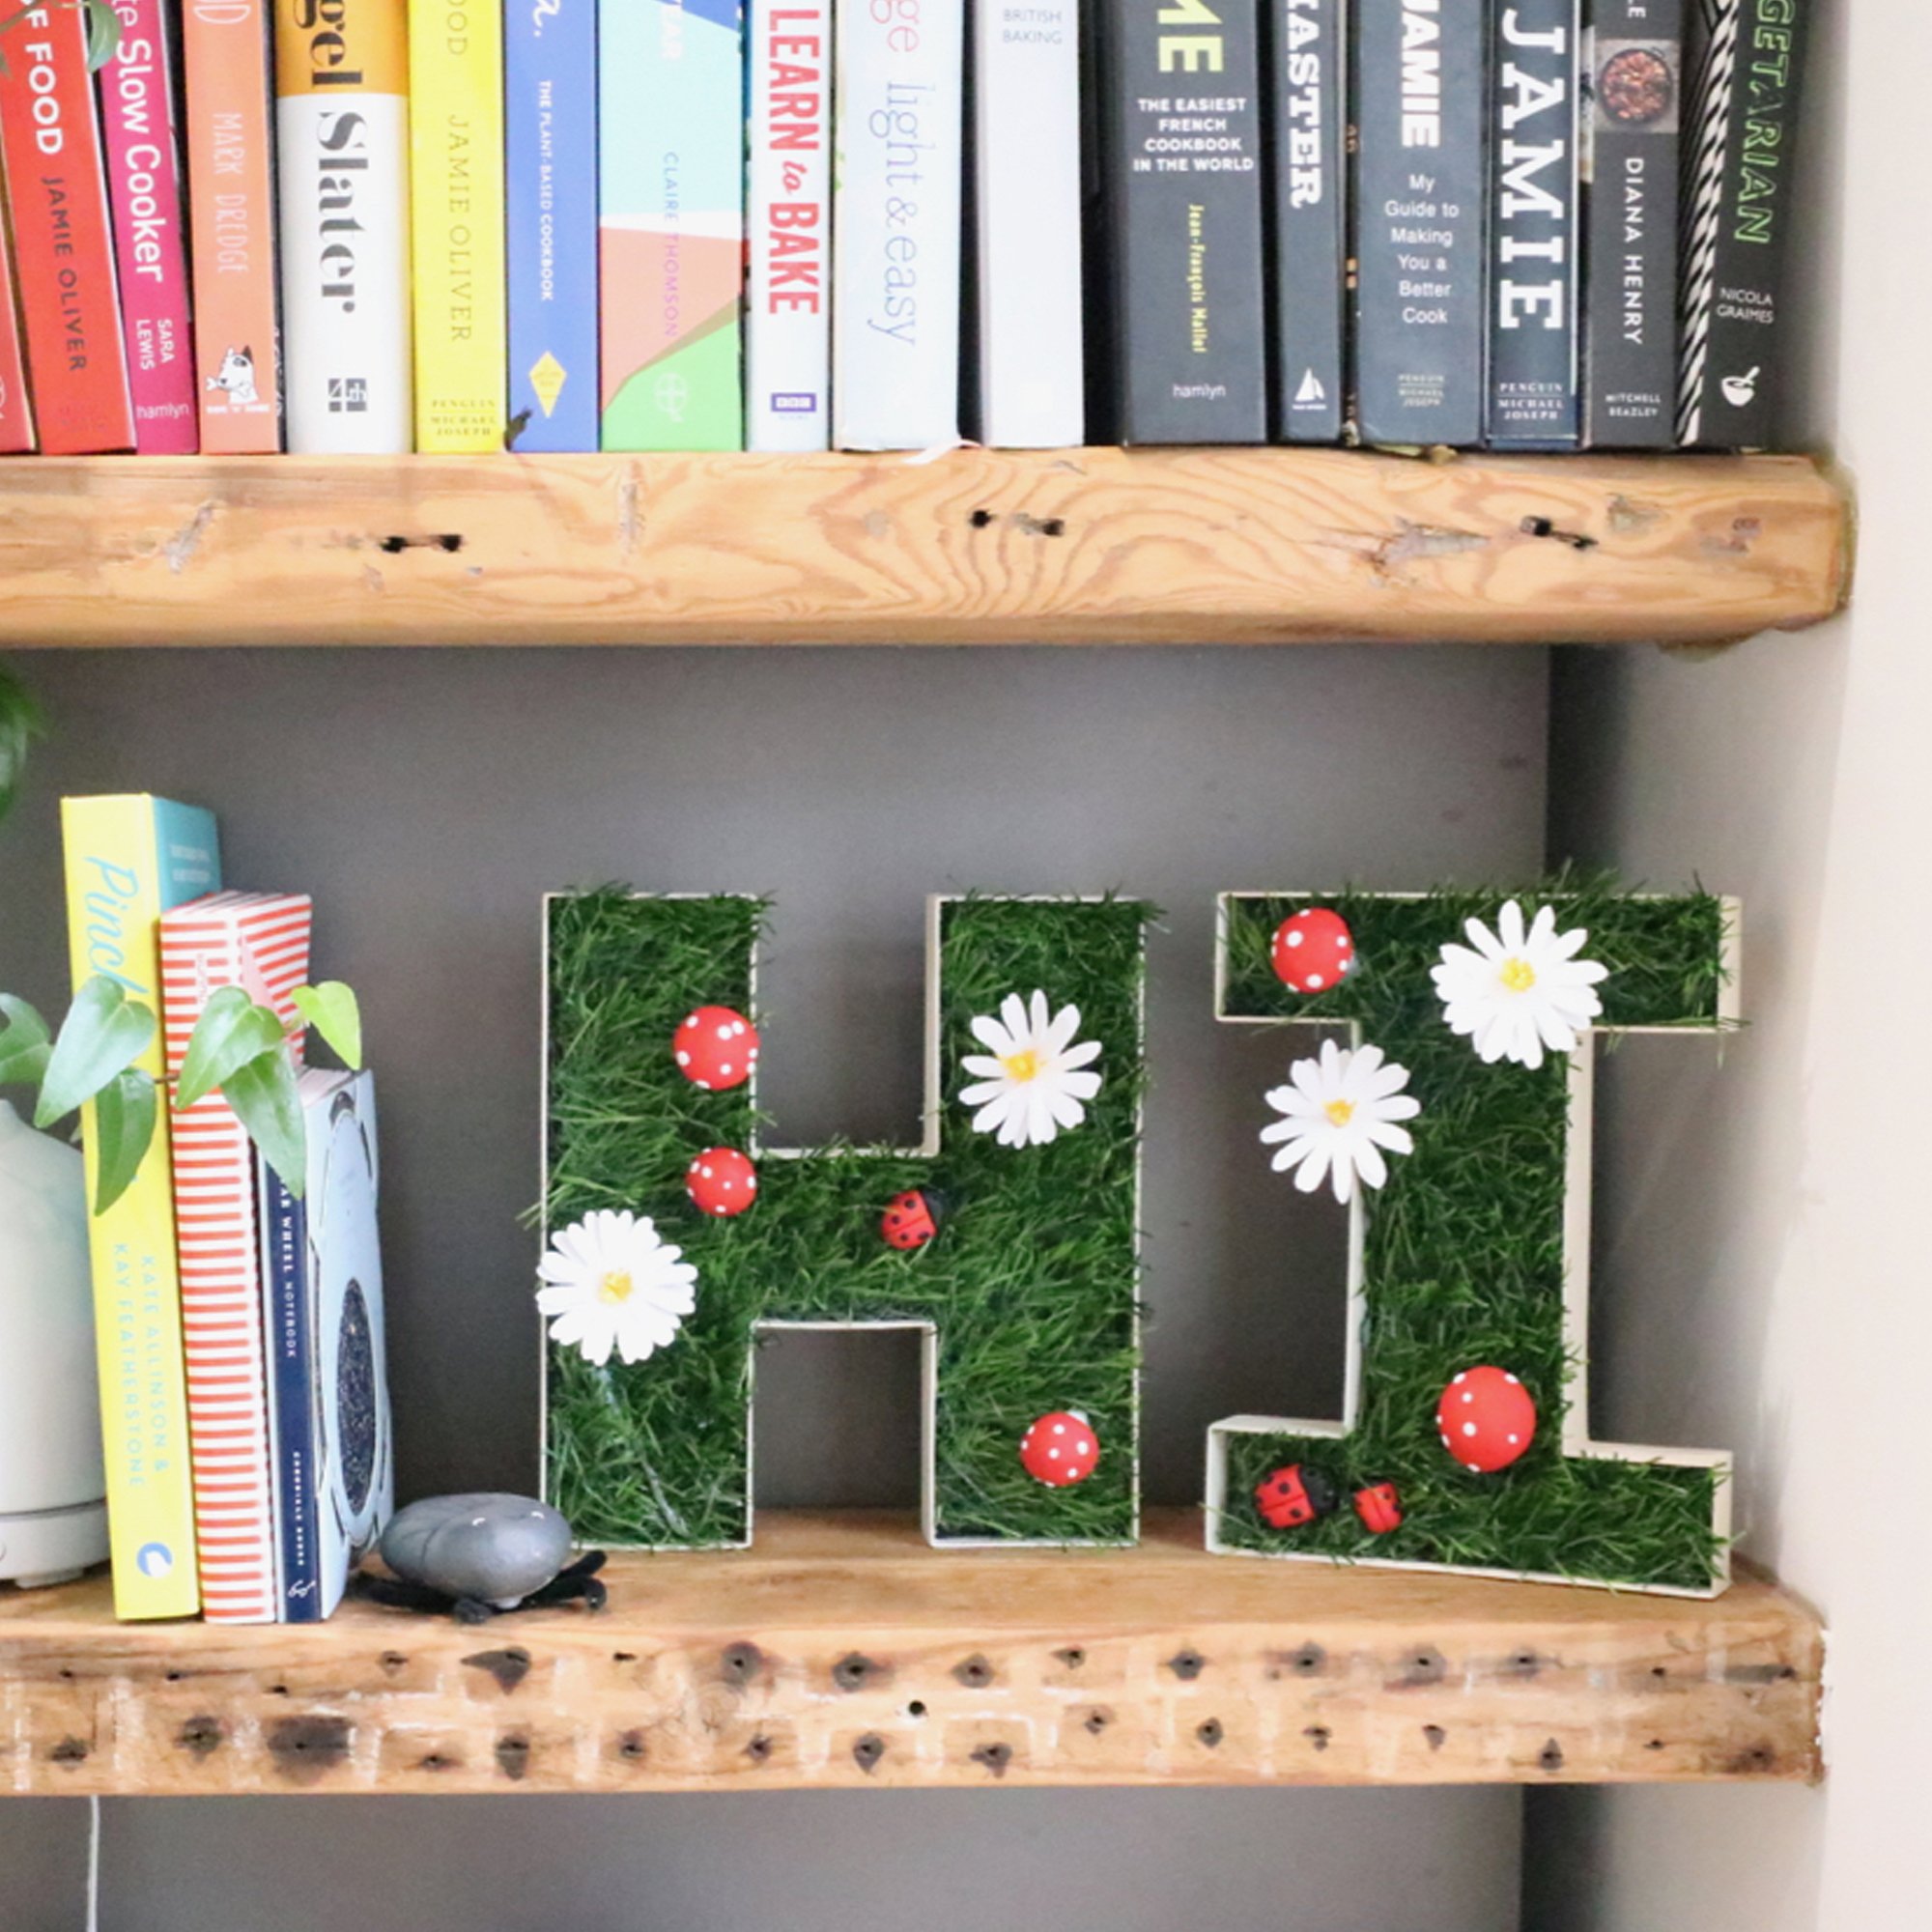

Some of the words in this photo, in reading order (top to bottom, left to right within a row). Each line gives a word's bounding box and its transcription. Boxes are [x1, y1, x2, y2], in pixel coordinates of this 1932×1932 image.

[1002, 8, 1062, 23] BRITISH
[1002, 29, 1063, 45] BAKING
[116, 39, 152, 134] Slow
[539, 80, 552, 108] THE
[769, 10, 819, 150] LEARN
[25, 43, 63, 155] FOOD
[1138, 99, 1169, 112] THE
[1175, 99, 1246, 112] EASIEST
[1287, 0, 1322, 210] ASTER
[869, 82, 935, 186] light
[1159, 119, 1227, 132] FRENCH
[213, 111, 243, 175] MARK
[1145, 138, 1242, 152] COOKBOOK
[448, 115, 470, 213] JAMIE
[782, 160, 808, 196] to
[1133, 158, 1151, 172] IN
[1156, 158, 1189, 172] THE
[1194, 158, 1254, 172] WORLD
[1499, 9, 1565, 328] JAMIE
[663, 152, 678, 221] CLAIRE
[1409, 174, 1435, 193] My
[1625, 157, 1644, 243] DIANA
[125, 145, 165, 283] Cooker
[885, 196, 918, 228] &
[1384, 200, 1436, 217] Guide
[1442, 201, 1460, 217] to
[216, 194, 249, 273] DREDGE
[1391, 228, 1454, 248] Making
[540, 213, 554, 300] COOKBOOK
[769, 203, 819, 314] BAKE
[1399, 255, 1431, 271] You
[1435, 258, 1447, 271] a
[42, 177, 73, 256] JAMIE
[58, 273, 87, 371] OLIVER
[449, 225, 472, 341] OLIVER
[664, 234, 678, 337] THOMSON
[867, 235, 917, 346] easy
[1399, 280, 1451, 298] Better
[1624, 255, 1642, 345] HENRY
[1720, 287, 1774, 305] NICOLA
[1403, 306, 1448, 325] Cook
[1717, 304, 1774, 325] GRAIMES
[136, 319, 156, 371] LEWIS
[157, 319, 176, 363] SARA
[1173, 383, 1227, 400] hamlyn
[1498, 399, 1564, 409] MICHAEL
[1499, 383, 1563, 393] PENGUIN
[1605, 394, 1662, 404] MITCHELL
[136, 403, 189, 419] hamlyn
[1503, 411, 1559, 420] JOSEPH
[1608, 407, 1659, 417] BEAZLEY
[142, 1256, 159, 1314] KATE
